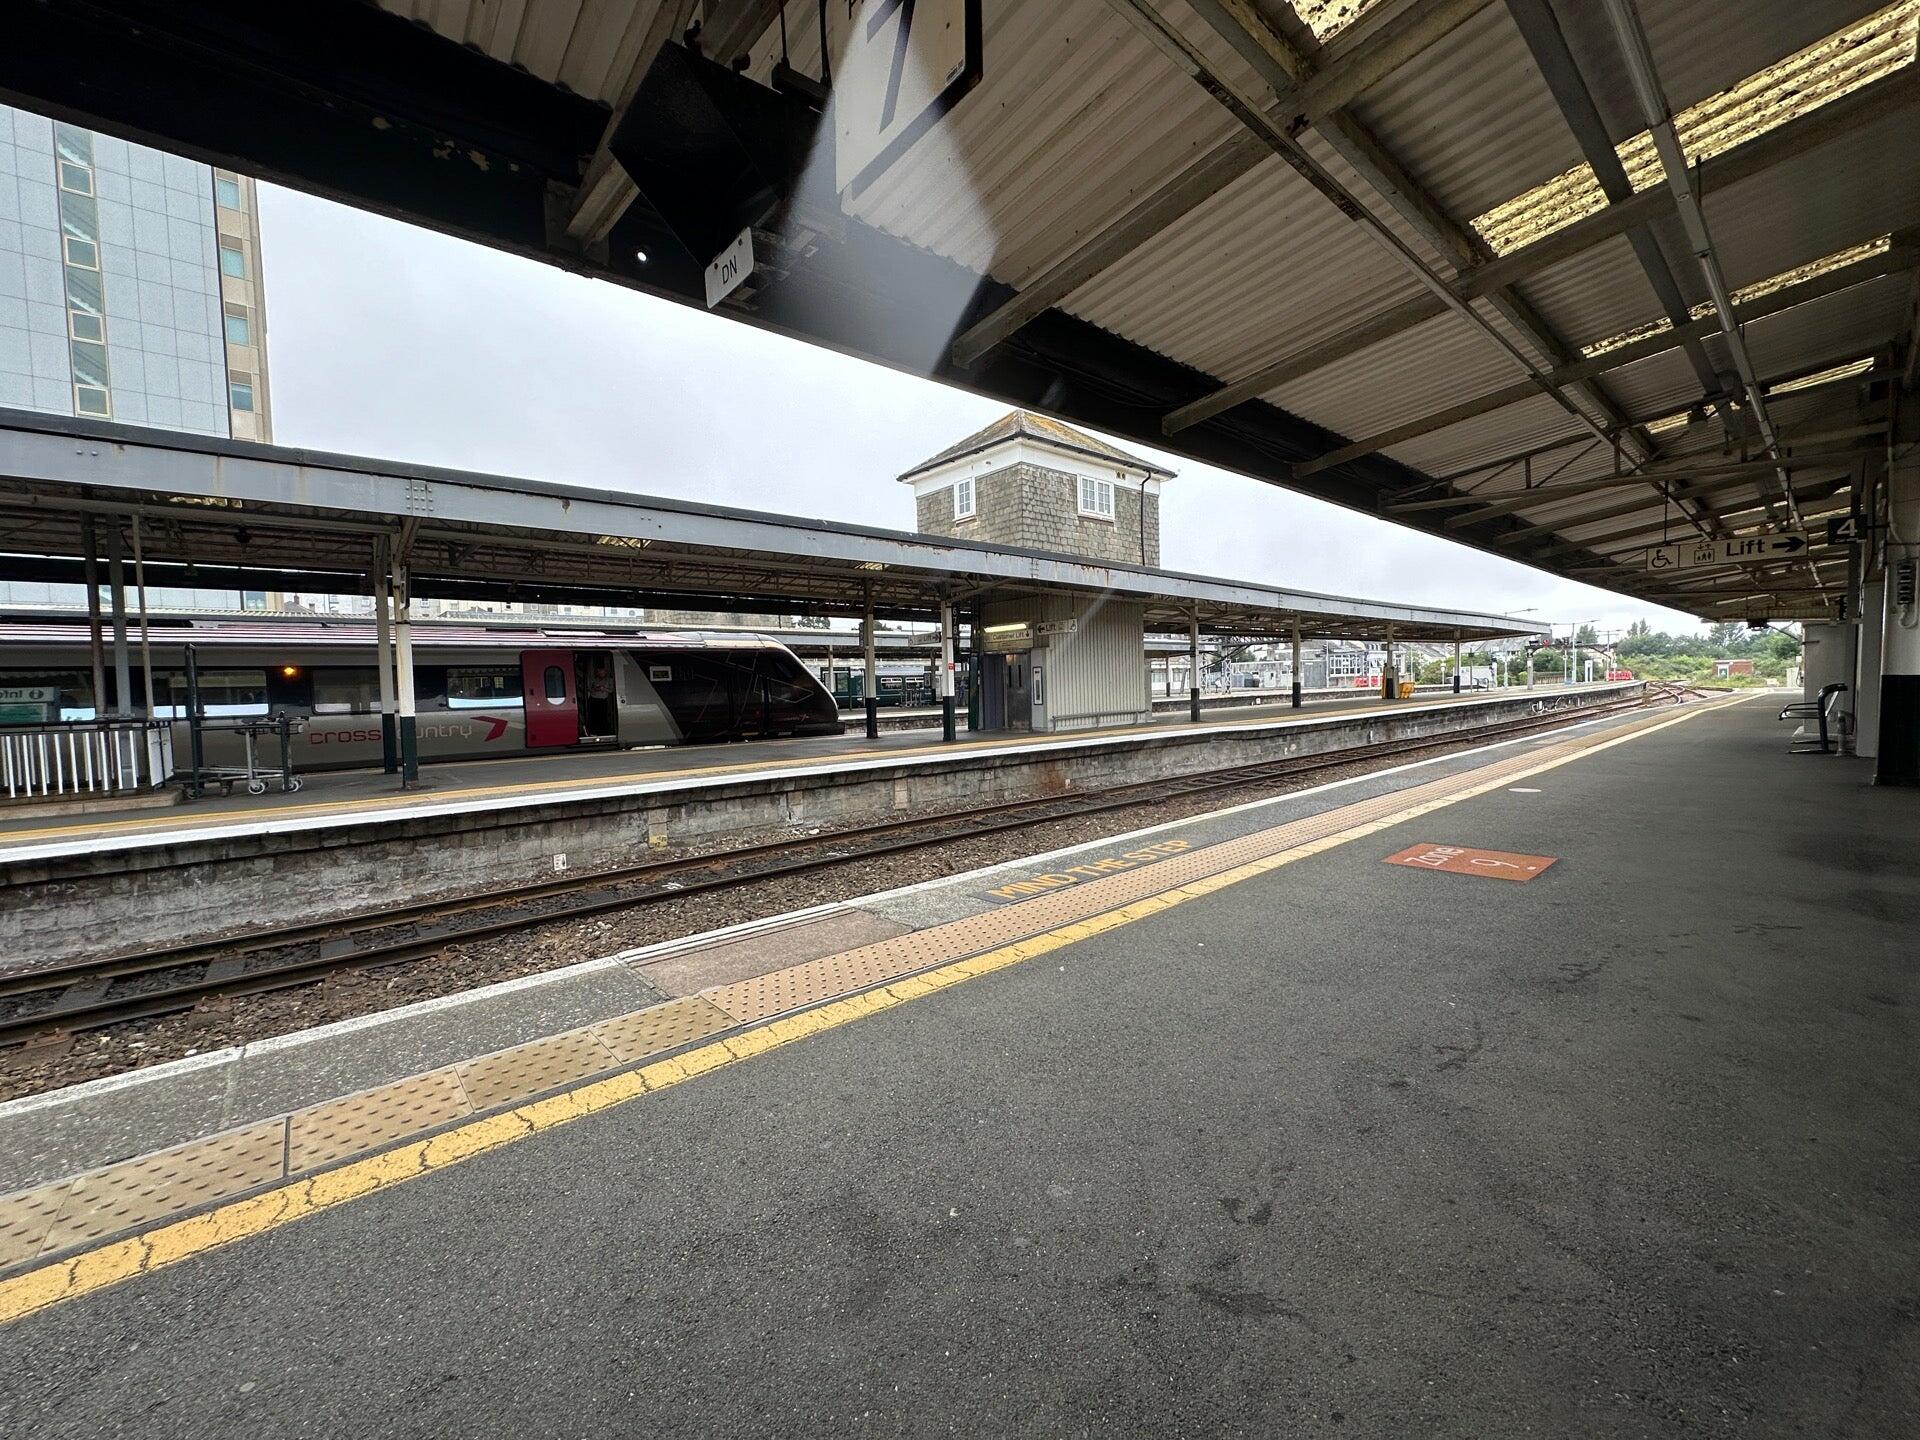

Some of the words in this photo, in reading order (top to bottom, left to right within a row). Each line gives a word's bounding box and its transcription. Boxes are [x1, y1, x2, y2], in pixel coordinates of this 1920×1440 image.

[722, 255, 737, 284] DN
[1836, 518, 1858, 537] 4
[1726, 539, 1765, 557] Lift
[992, 631, 1015, 641] Customer
[1015, 630, 1025, 639] Lift
[1045, 622, 1057, 631] Lift
[1403, 847, 1465, 867] Zone
[985, 873, 1078, 899] MIND
[1065, 858, 1137, 876] THE
[1122, 840, 1192, 861] STEP
